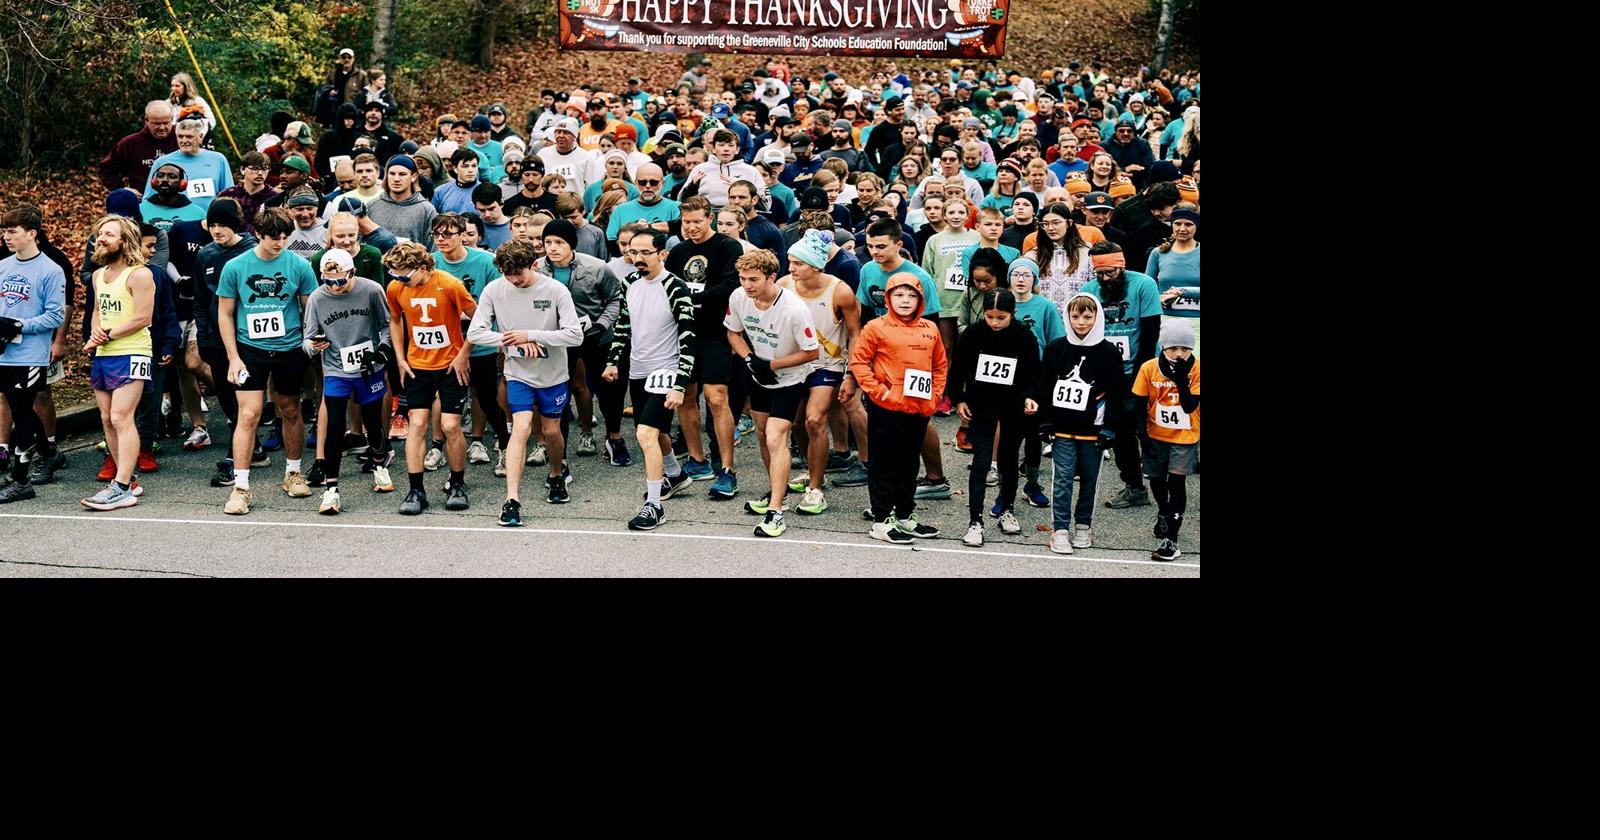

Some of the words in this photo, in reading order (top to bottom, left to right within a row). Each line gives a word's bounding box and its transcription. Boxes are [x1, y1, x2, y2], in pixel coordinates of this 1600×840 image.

[620, 0, 713, 24] HAPPY
[727, 0, 949, 30] THANKSGIVING
[970, 6, 992, 15] TROT
[977, 14, 988, 22] 5K
[619, 32, 645, 44] Thank
[646, 34, 661, 46] you
[663, 32, 676, 45] for
[677, 33, 725, 48] supporting
[726, 34, 740, 46] the
[742, 34, 791, 47] Greeneville
[793, 35, 810, 50] City
[811, 35, 846, 49] Schools
[848, 36, 893, 50] Education
[894, 37, 948, 51] Foundation!
[193, 183, 207, 193] 51
[2, 281, 31, 296] STATE
[410, 297, 437, 323] T
[253, 317, 279, 333] 676
[418, 331, 444, 345] 279
[131, 361, 151, 377] 760
[982, 361, 1011, 378] 125
[649, 374, 672, 388] 111
[909, 375, 931, 393] 768
[1057, 386, 1084, 404] 513
[1161, 410, 1180, 425] 54
